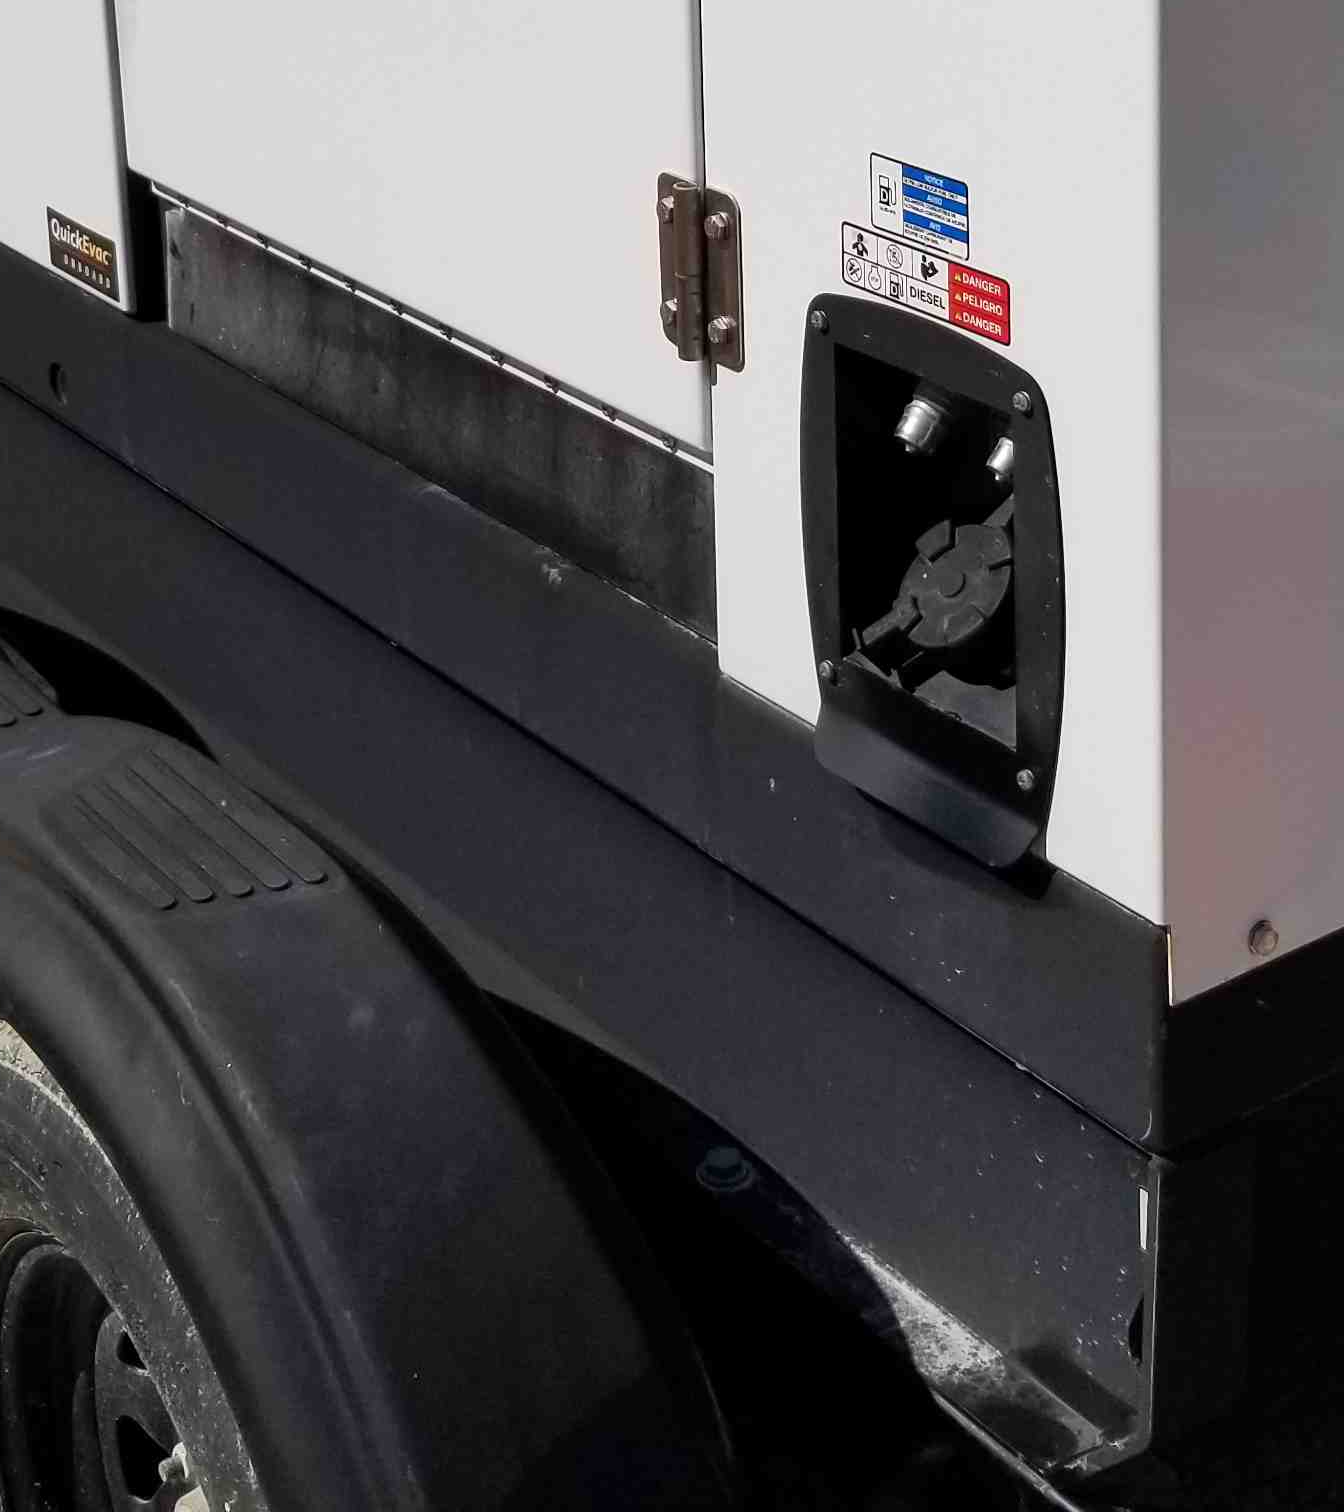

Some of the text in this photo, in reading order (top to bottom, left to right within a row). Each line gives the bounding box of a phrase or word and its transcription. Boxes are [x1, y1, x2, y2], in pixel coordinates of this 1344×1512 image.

[962, 272, 1002, 297] DANGER
[909, 285, 946, 310] DIESEL
[962, 292, 1003, 316] PELIGRO
[962, 312, 1003, 337] DANGER
